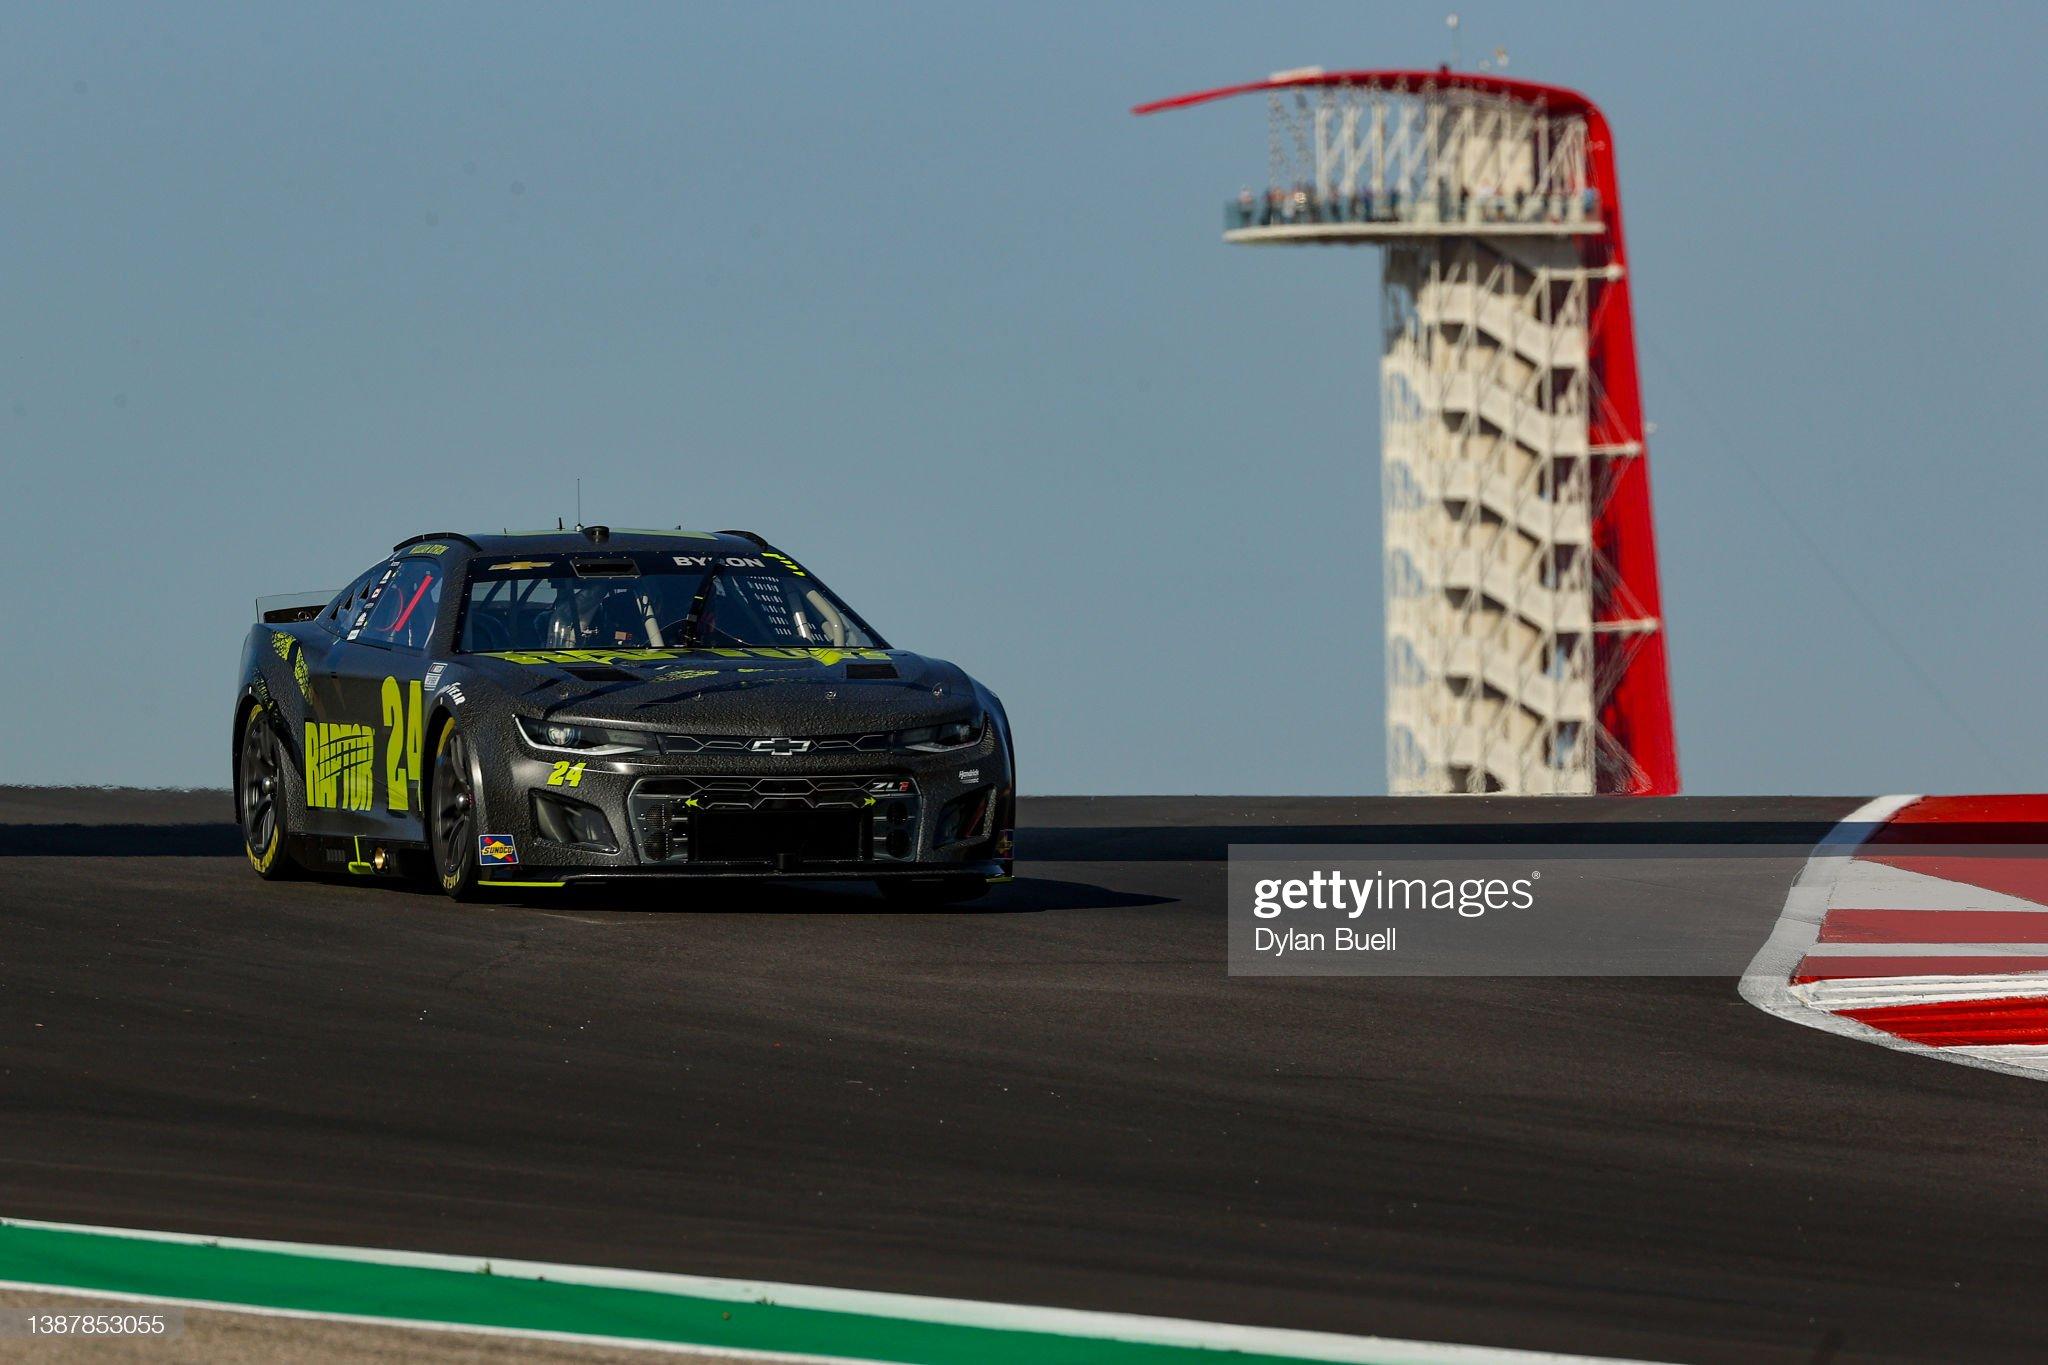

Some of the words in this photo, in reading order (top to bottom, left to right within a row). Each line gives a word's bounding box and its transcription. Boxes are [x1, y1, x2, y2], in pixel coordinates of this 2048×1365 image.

[672, 556, 766, 568] BYON
[381, 675, 423, 812] 24
[304, 721, 375, 812] RAPTOR
[546, 760, 587, 787] 24
[483, 846, 513, 855] SUNOCO
